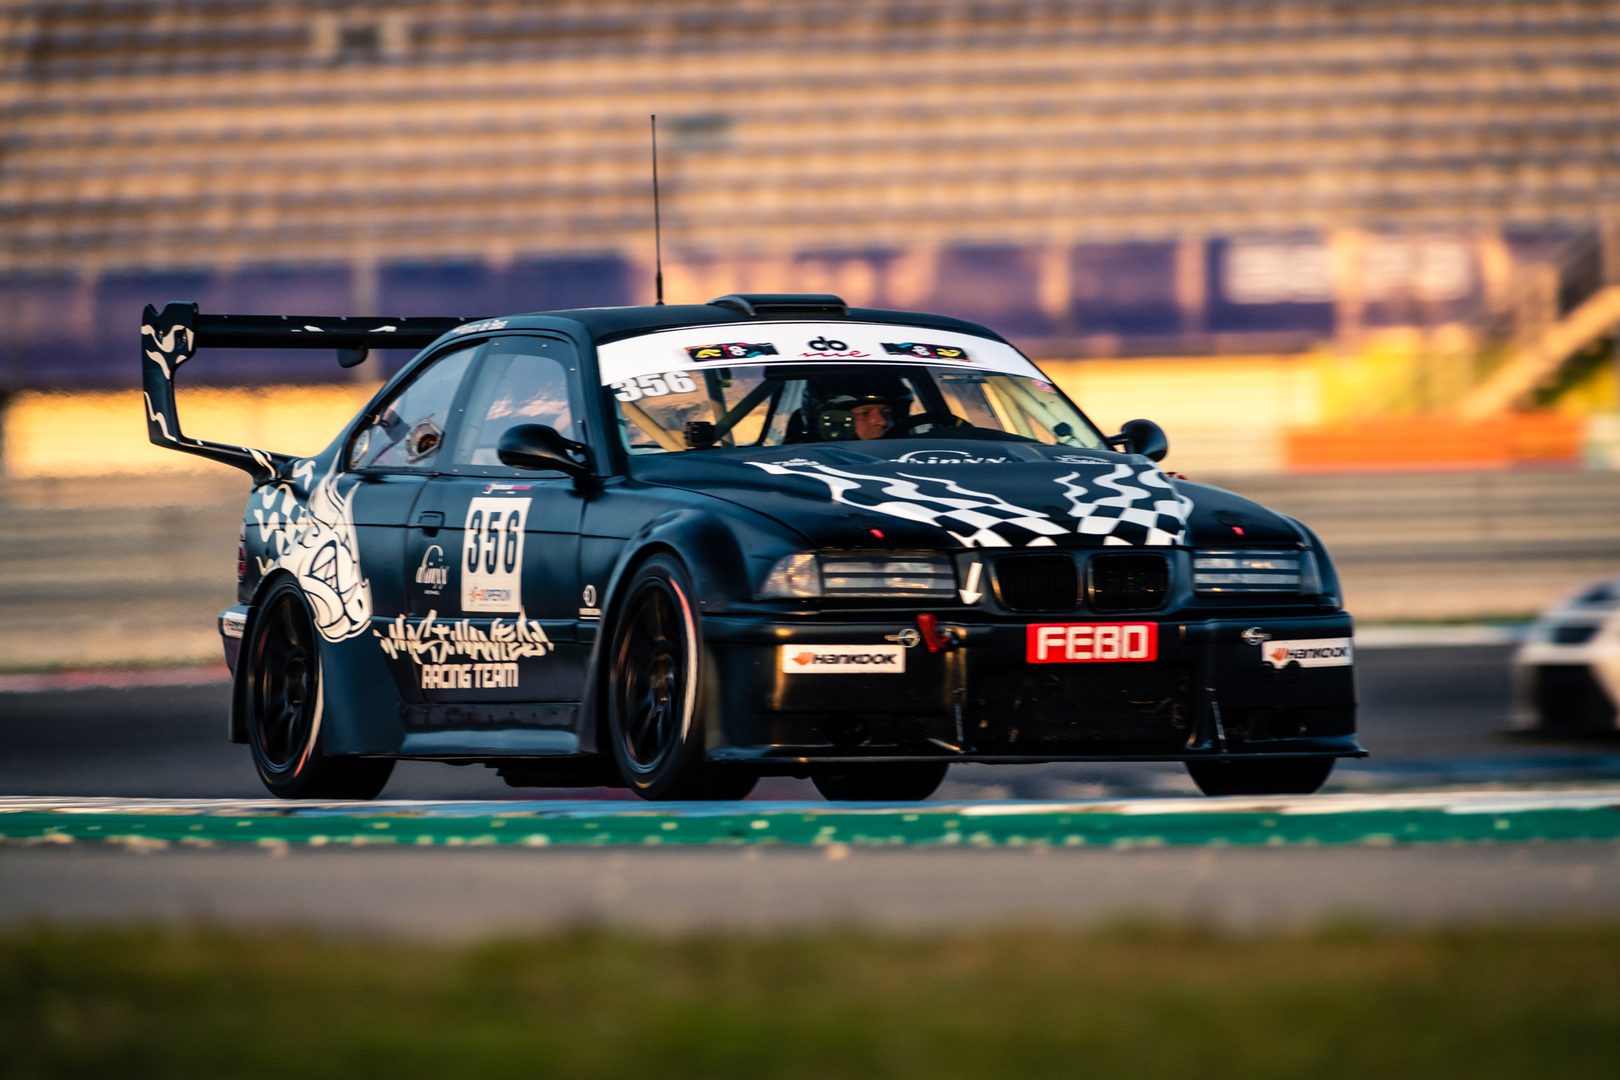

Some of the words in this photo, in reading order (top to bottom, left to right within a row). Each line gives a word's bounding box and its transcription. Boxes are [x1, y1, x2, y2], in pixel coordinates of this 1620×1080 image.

[610, 371, 697, 402] 356
[467, 508, 521, 575] 356
[1037, 625, 1149, 660] FEBO
[421, 663, 473, 690] RACING
[472, 662, 519, 689] TEAM
